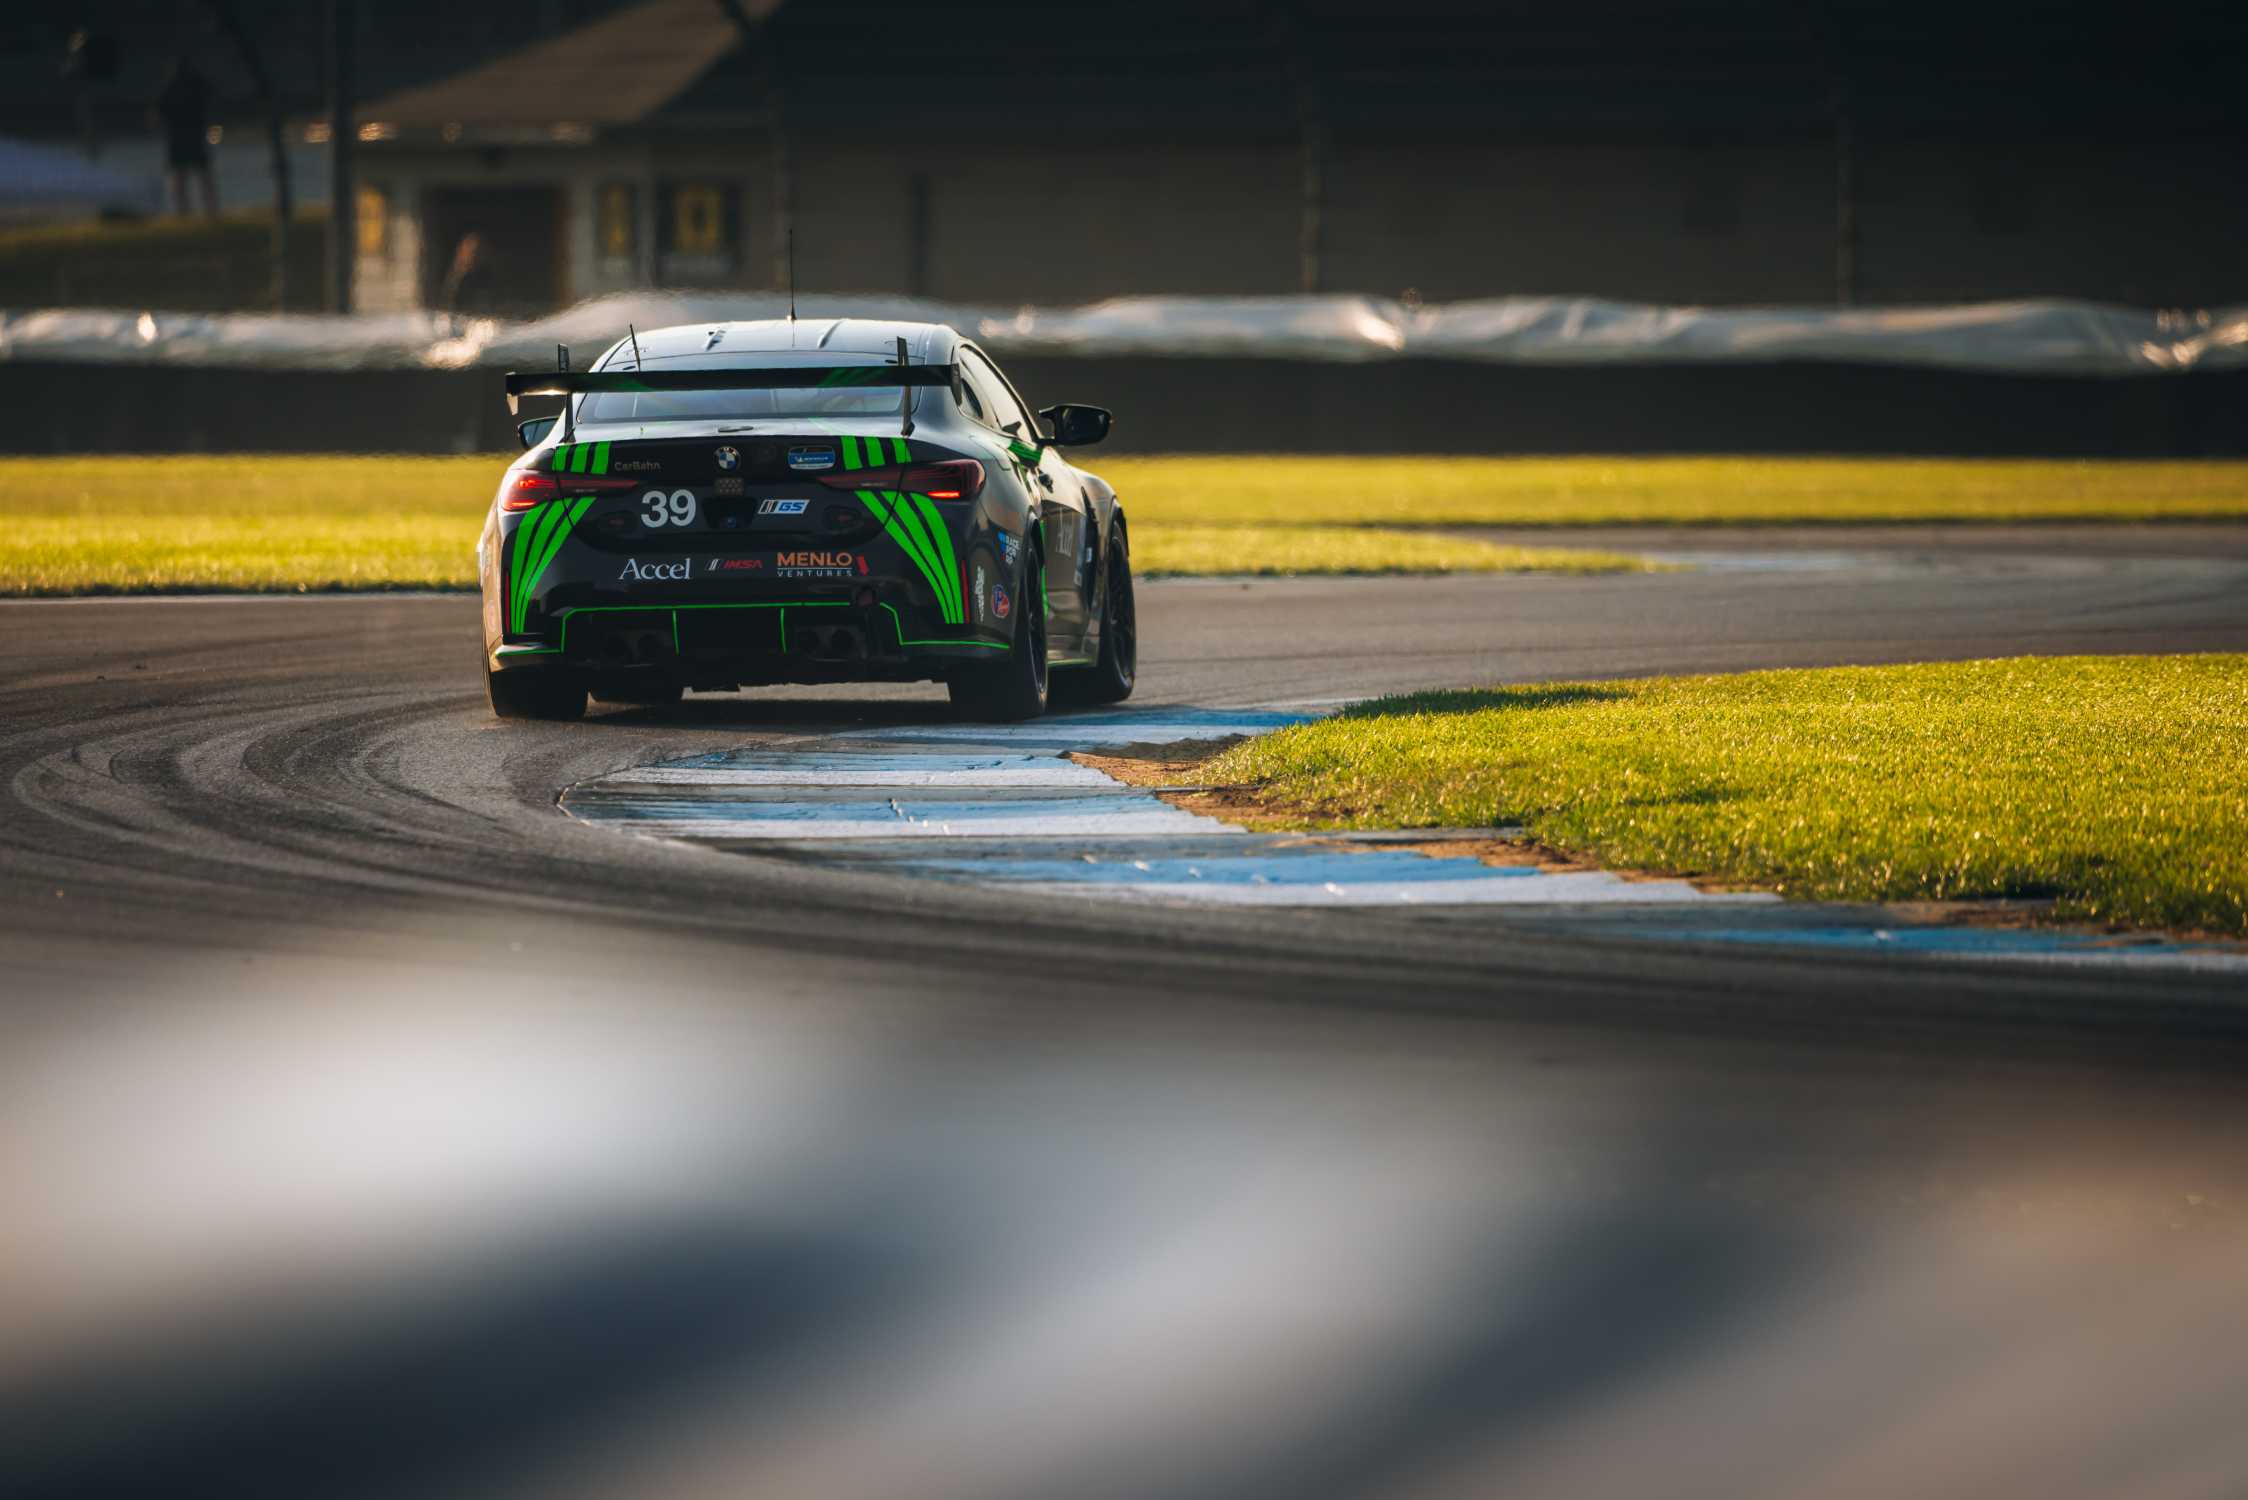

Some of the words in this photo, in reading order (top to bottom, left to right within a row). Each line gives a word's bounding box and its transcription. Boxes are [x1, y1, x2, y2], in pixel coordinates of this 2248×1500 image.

[641, 489, 697, 528] 39
[779, 502, 805, 512] GS
[723, 559, 763, 569] IMSA
[777, 552, 852, 566] MENLO
[618, 558, 691, 580] Accel
